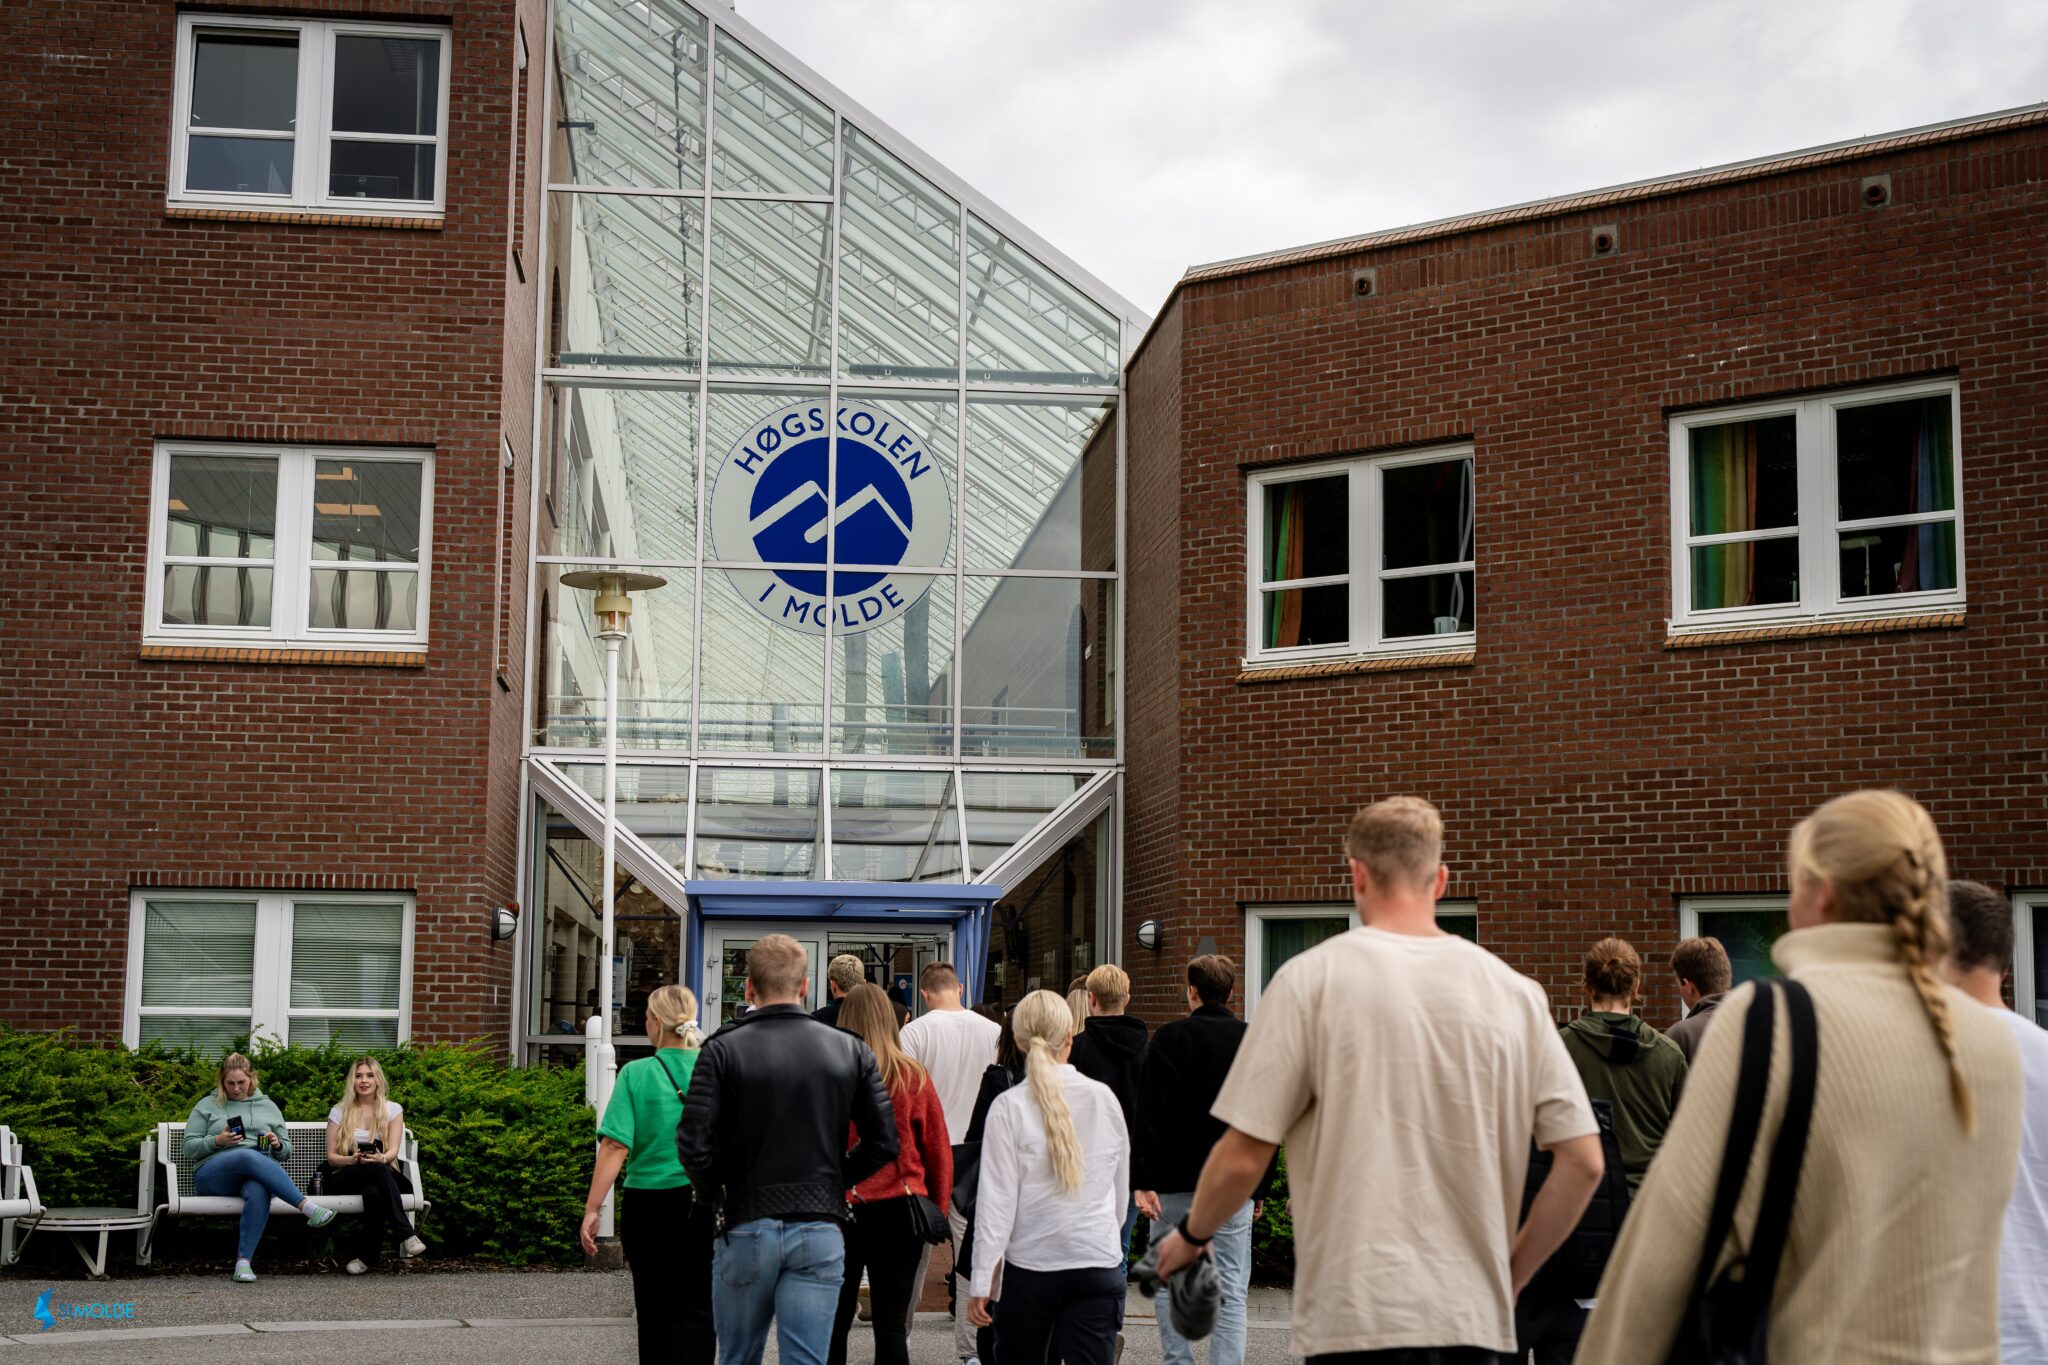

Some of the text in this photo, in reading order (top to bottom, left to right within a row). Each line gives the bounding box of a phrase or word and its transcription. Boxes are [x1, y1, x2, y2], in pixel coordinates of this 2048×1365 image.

[734, 408, 931, 480] HØGSKOLEN
[759, 583, 904, 628] I MOLDE
